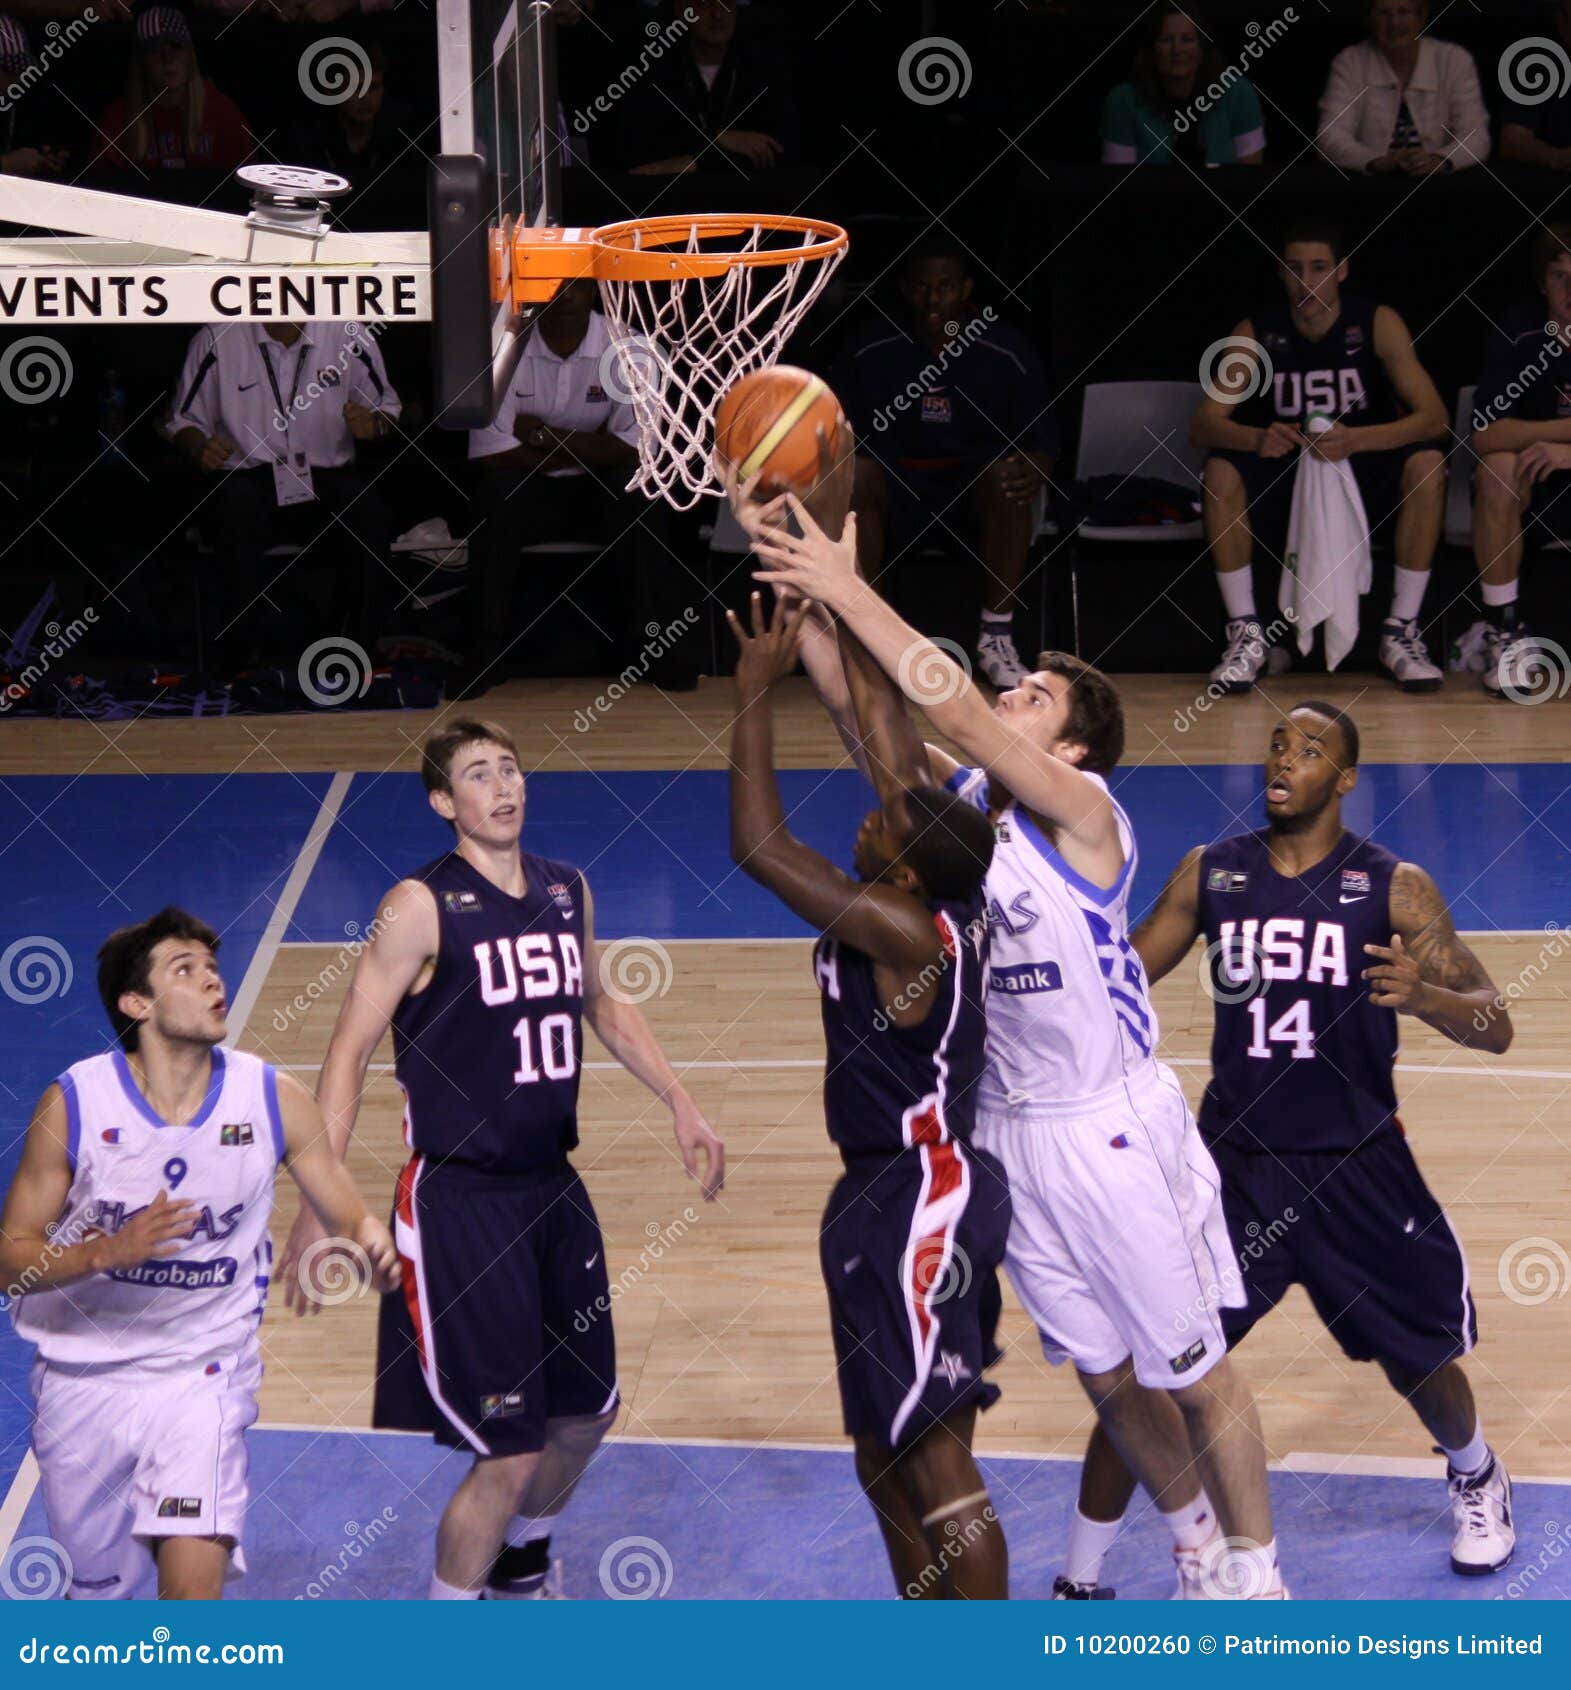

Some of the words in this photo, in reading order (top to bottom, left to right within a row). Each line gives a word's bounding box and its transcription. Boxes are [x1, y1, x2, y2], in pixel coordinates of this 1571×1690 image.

[0, 276, 168, 317] VENTS
[210, 276, 417, 316] CENTRE
[1273, 367, 1368, 417] USA
[474, 933, 583, 1006] USA
[1219, 918, 1348, 986] USA
[992, 966, 1050, 991] bank
[512, 1013, 575, 1083] 10
[1247, 998, 1315, 1059] 14
[164, 1157, 187, 1191] 9
[97, 1201, 243, 1241] HAS
